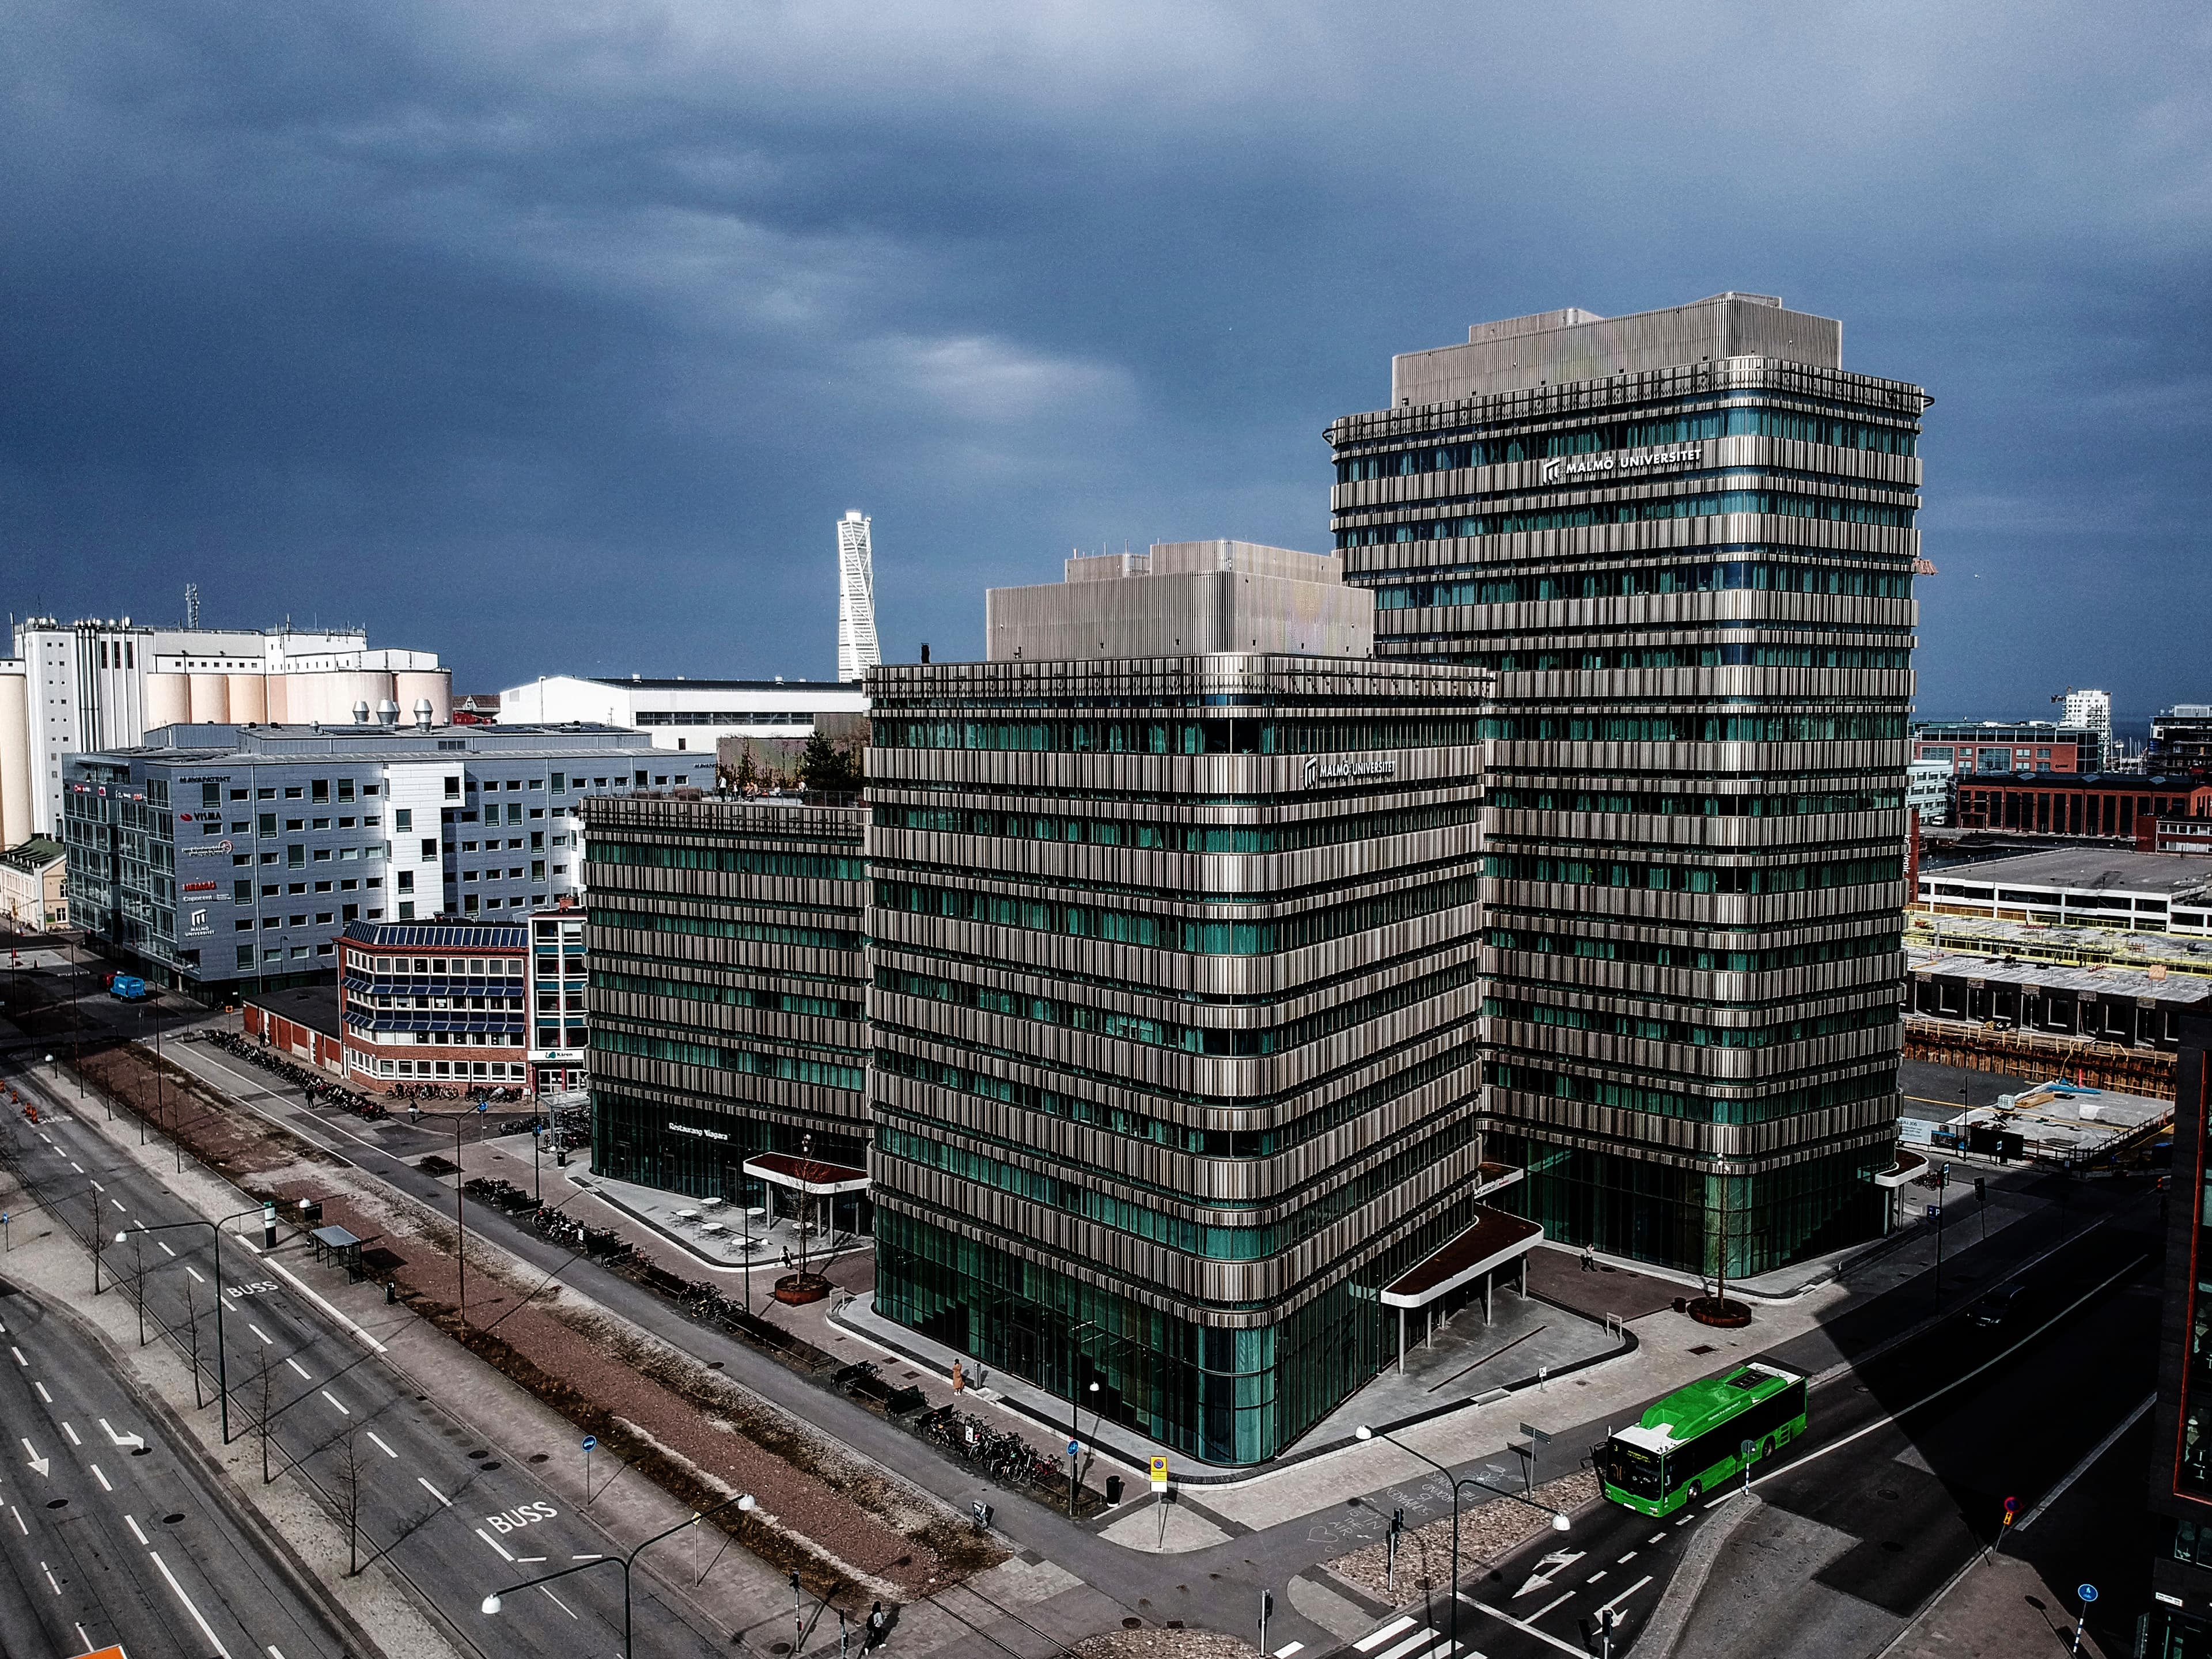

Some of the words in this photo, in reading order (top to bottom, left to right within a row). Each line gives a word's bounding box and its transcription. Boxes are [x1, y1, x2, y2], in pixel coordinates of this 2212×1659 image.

[1566, 457, 1614, 474] MALMÖ
[1620, 449, 1702, 468] UNIVERSITET
[1320, 760, 1349, 778] MALMÖ
[1353, 760, 1395, 775] UNIVERSITET
[194, 812, 222, 821] VISMA
[669, 1122, 703, 1137] Restaurang
[226, 1281, 279, 1298] BUSS
[1459, 1490, 1479, 1502] THE
[486, 1501, 558, 1534] BUSS
[1363, 1518, 1383, 1530] IN
[1328, 1521, 1353, 1537] AIR
